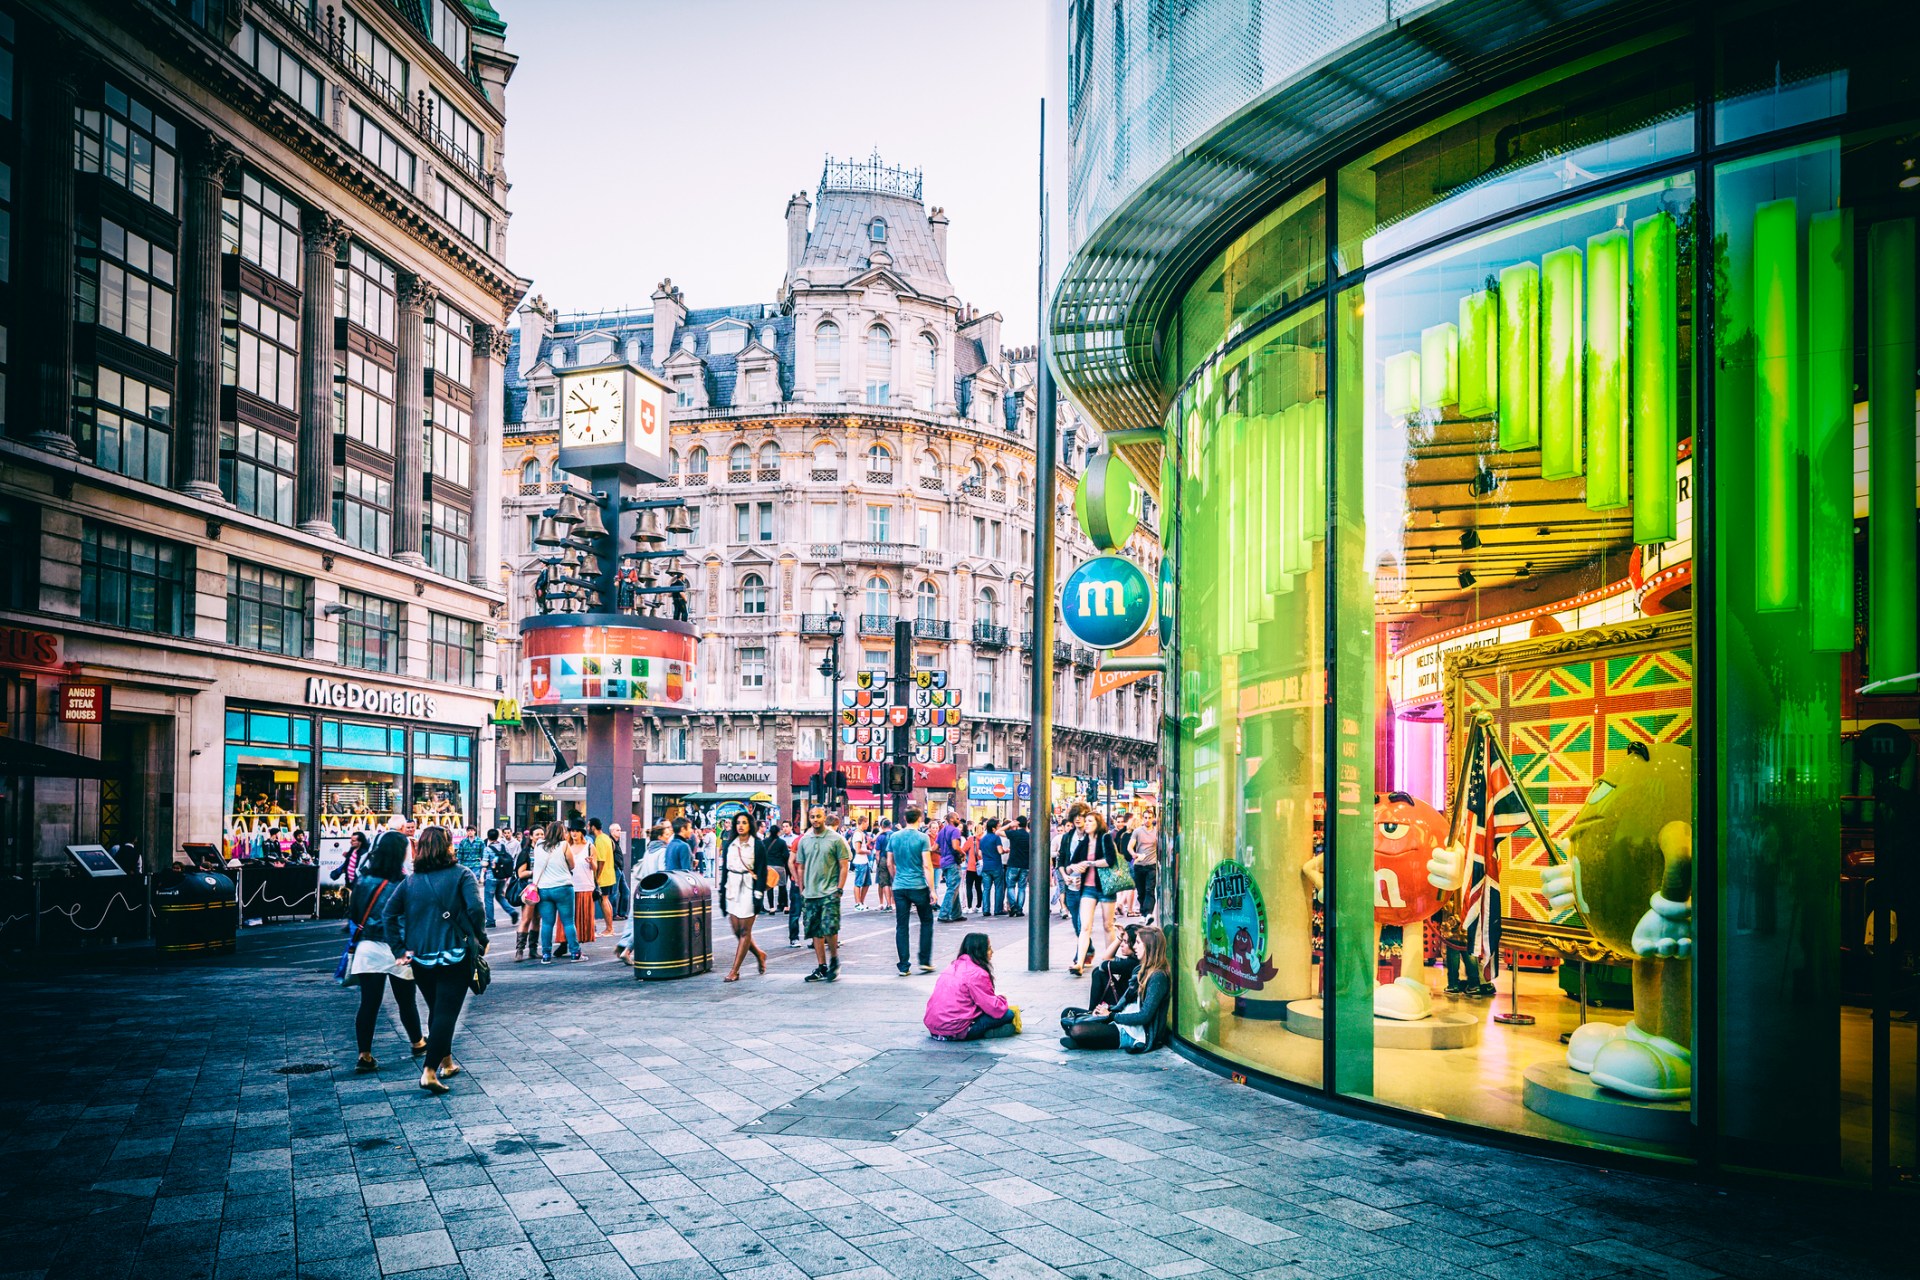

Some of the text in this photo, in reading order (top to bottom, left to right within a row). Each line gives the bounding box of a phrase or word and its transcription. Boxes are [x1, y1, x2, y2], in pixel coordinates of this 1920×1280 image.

[1078, 580, 1126, 617] m
[67, 687, 96, 697] ANGUS
[306, 677, 438, 718] McDonald's
[69, 699, 94, 708] STEAK
[65, 710, 96, 720] HOUSES
[720, 773, 771, 783] PICCADILLY
[976, 775, 1007, 785] MONEY
[970, 786, 1013, 795] EXCHE
[1019, 786, 1030, 795] 24
